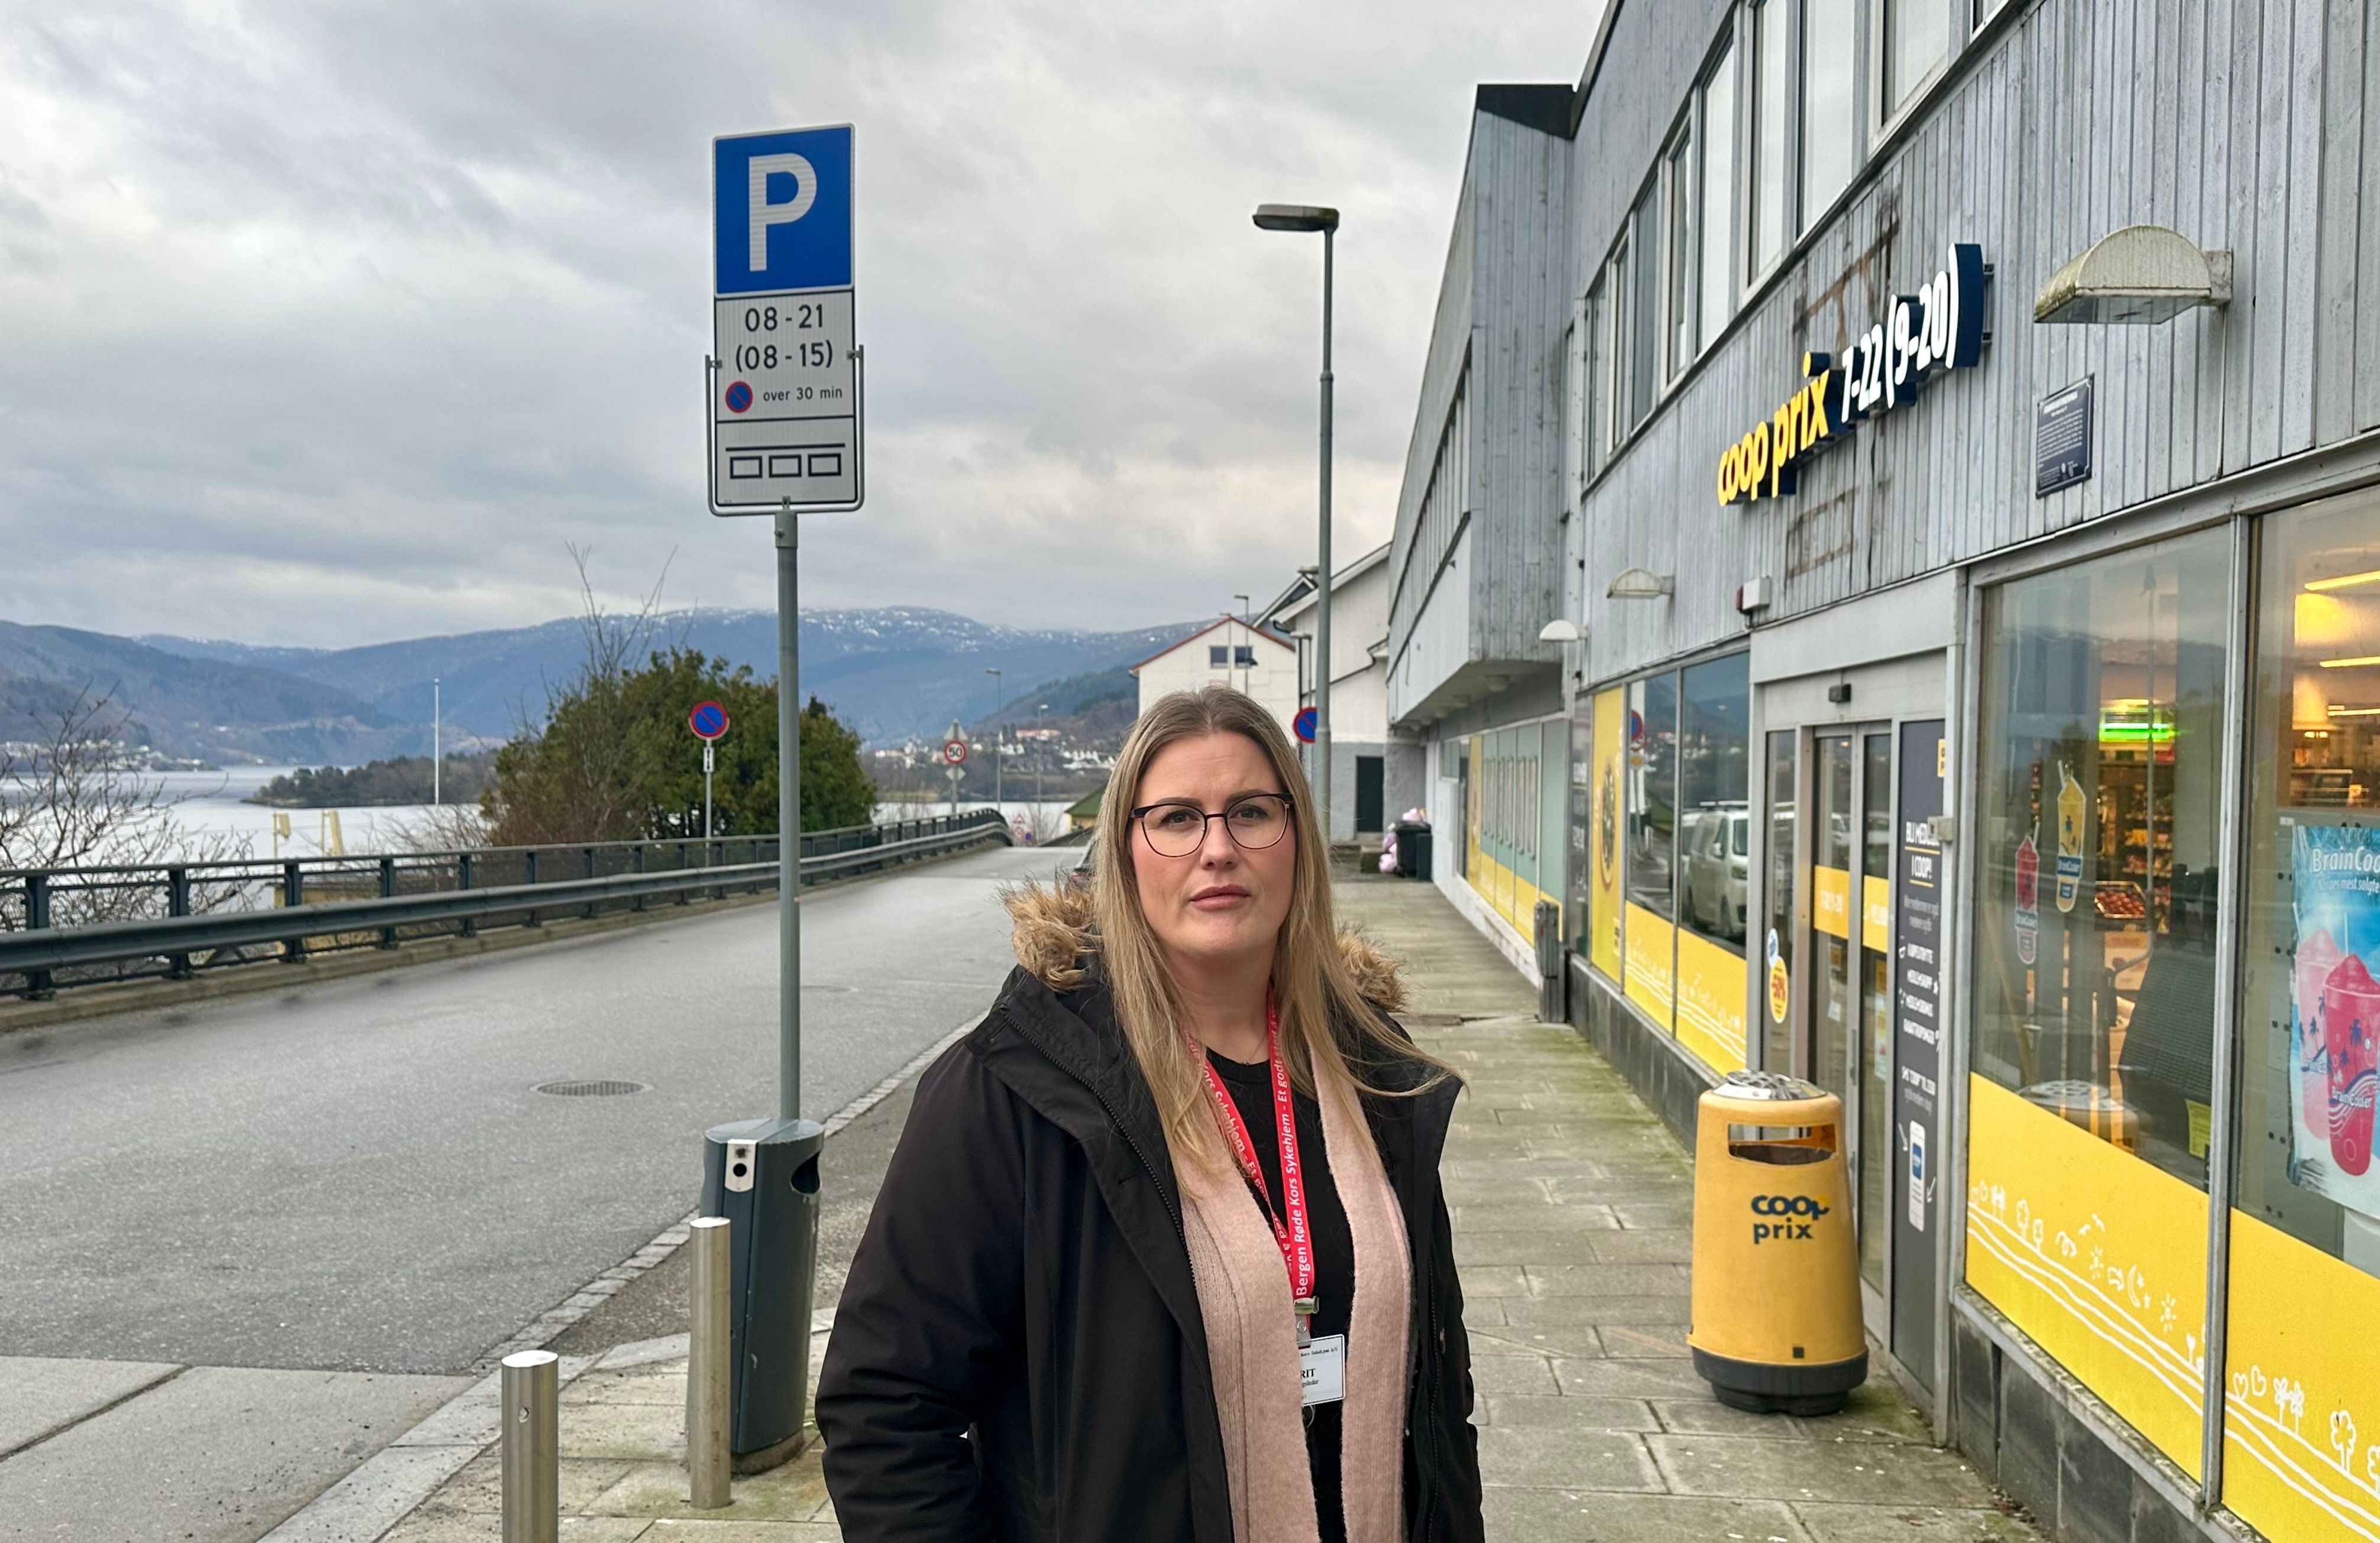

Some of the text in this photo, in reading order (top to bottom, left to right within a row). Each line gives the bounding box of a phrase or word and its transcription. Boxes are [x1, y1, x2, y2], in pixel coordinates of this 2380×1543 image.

[749, 153, 817, 272] P
[763, 385, 843, 402] over 30 min
[1718, 421, 1769, 507] coop
[1772, 351, 1829, 498] prix
[948, 747, 963, 757] 50
[1277, 1090, 1287, 1103] Et
[1281, 1113, 1298, 1175] Sykehjem
[1288, 1178, 1301, 1206] Kors
[1751, 1195, 1830, 1220] coop
[1291, 1209, 1306, 1243] Røde
[1753, 1217, 1812, 1244] prix
[1296, 1247, 1311, 1296] Bergen
